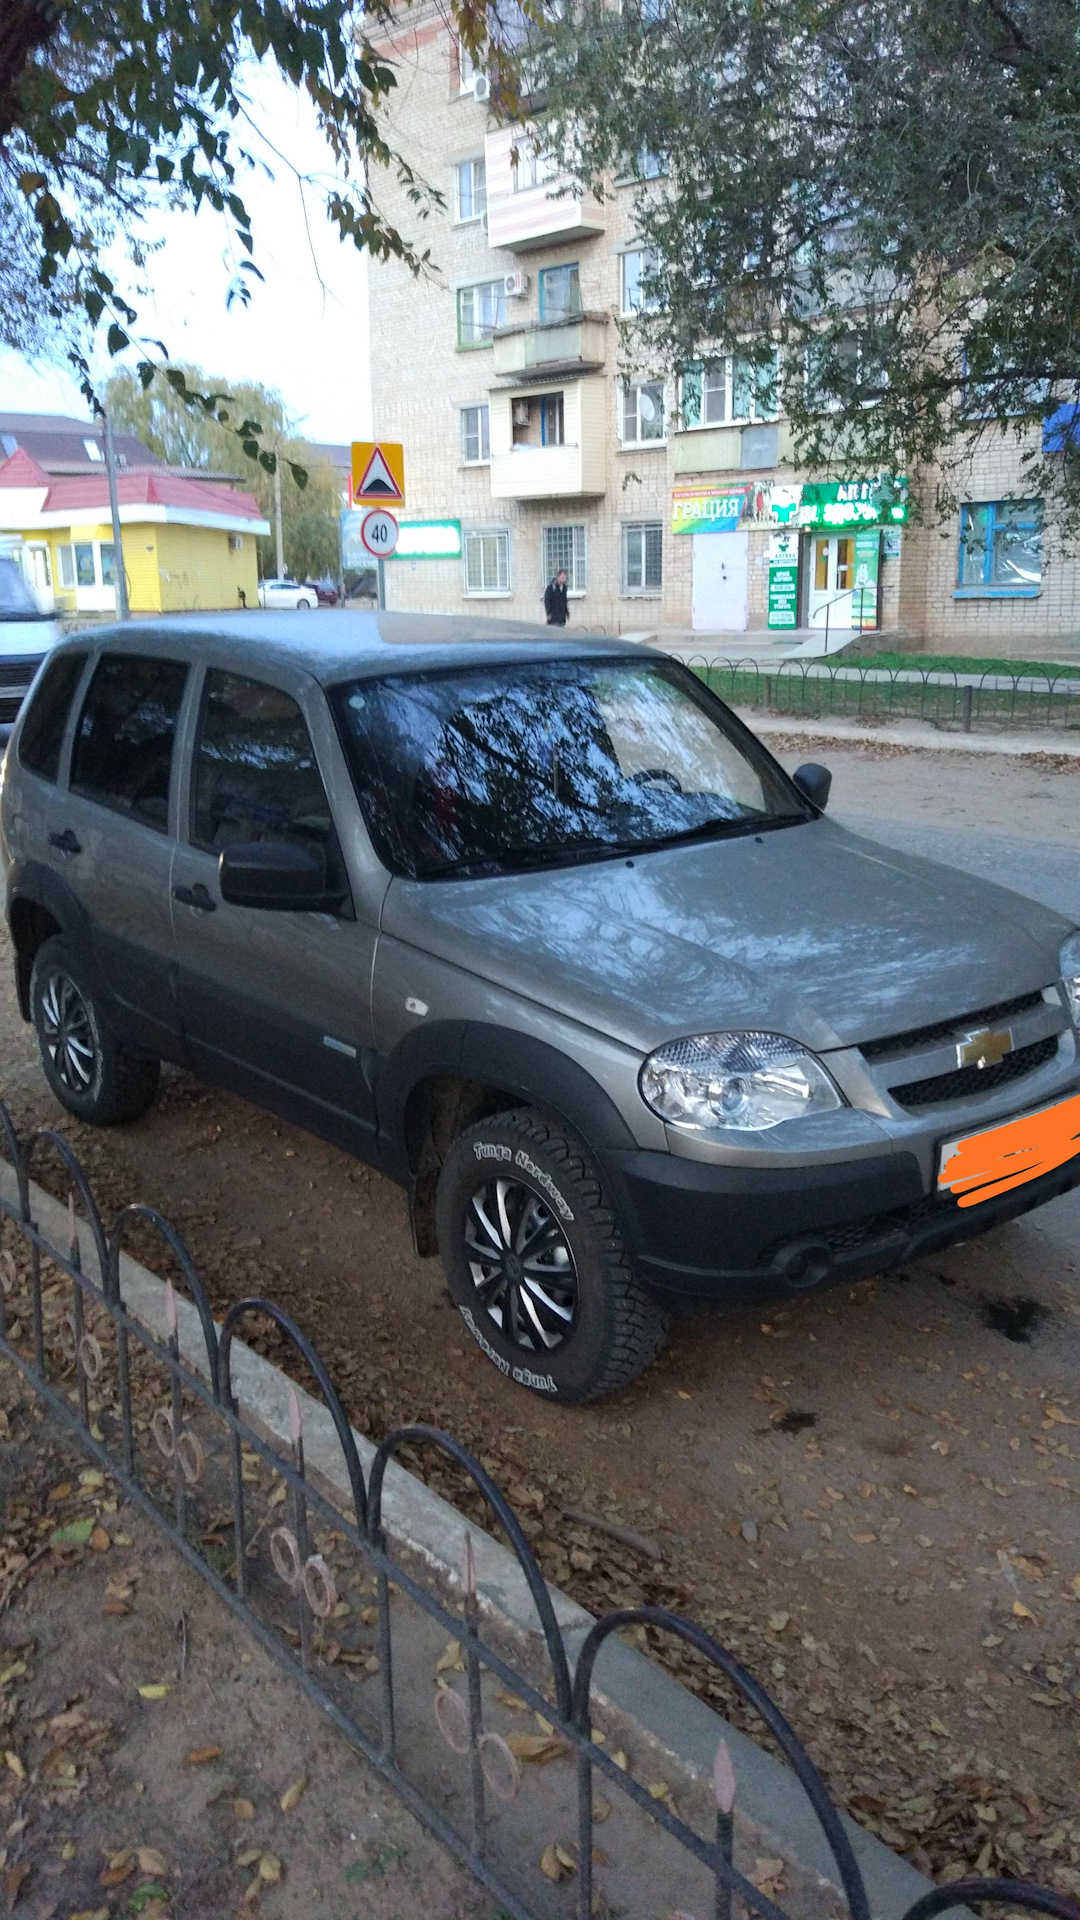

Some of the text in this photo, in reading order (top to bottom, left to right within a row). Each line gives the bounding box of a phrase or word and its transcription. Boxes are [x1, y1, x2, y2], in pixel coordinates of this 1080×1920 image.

[672, 498, 740, 523] ГРАЦИЯ
[371, 524, 388, 543] 40
[473, 1141, 575, 1222] Tunga Nordway
[512, 1364, 559, 1393] Tunga
